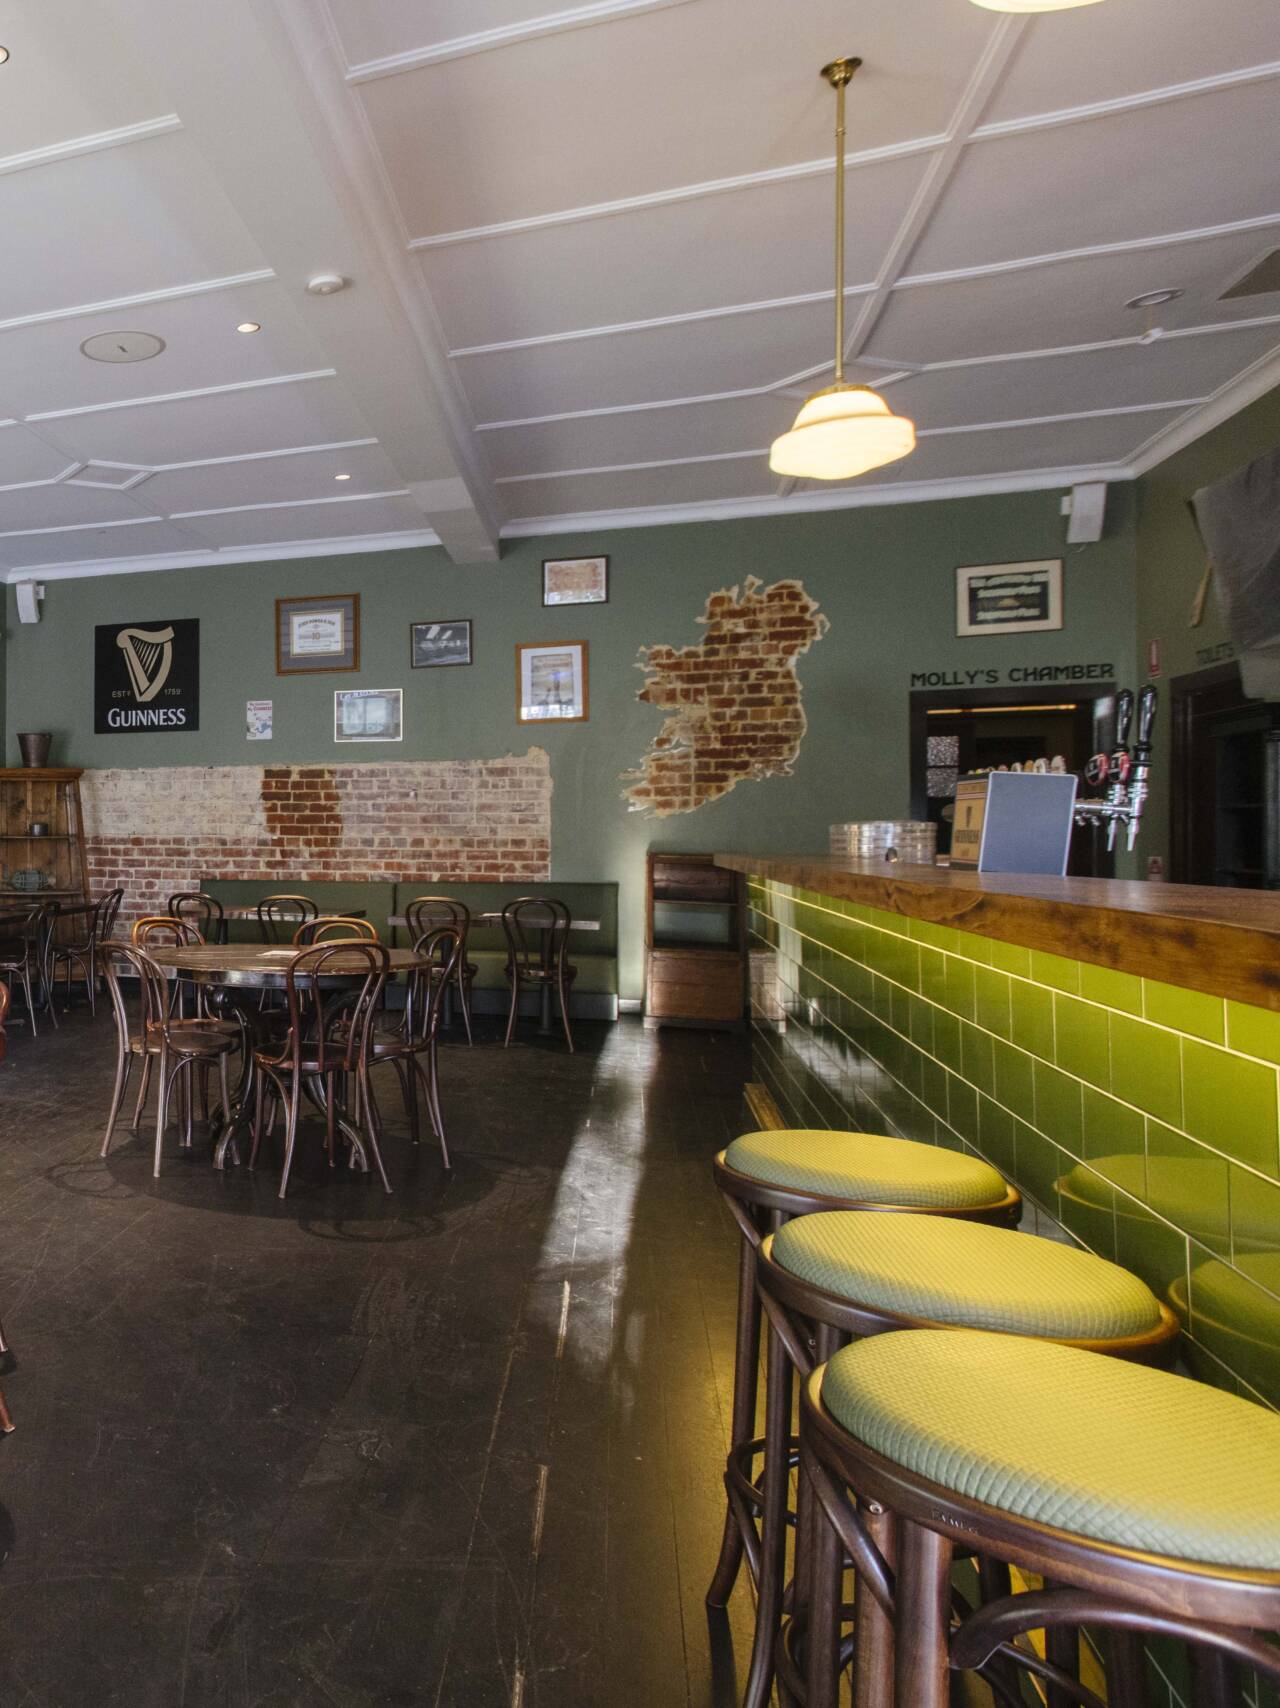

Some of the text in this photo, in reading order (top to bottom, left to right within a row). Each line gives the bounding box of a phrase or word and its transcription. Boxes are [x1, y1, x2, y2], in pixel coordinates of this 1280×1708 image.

[910, 663, 1115, 687] MOLLY'S CHAMBER
[107, 708, 187, 728] GUINNESS
